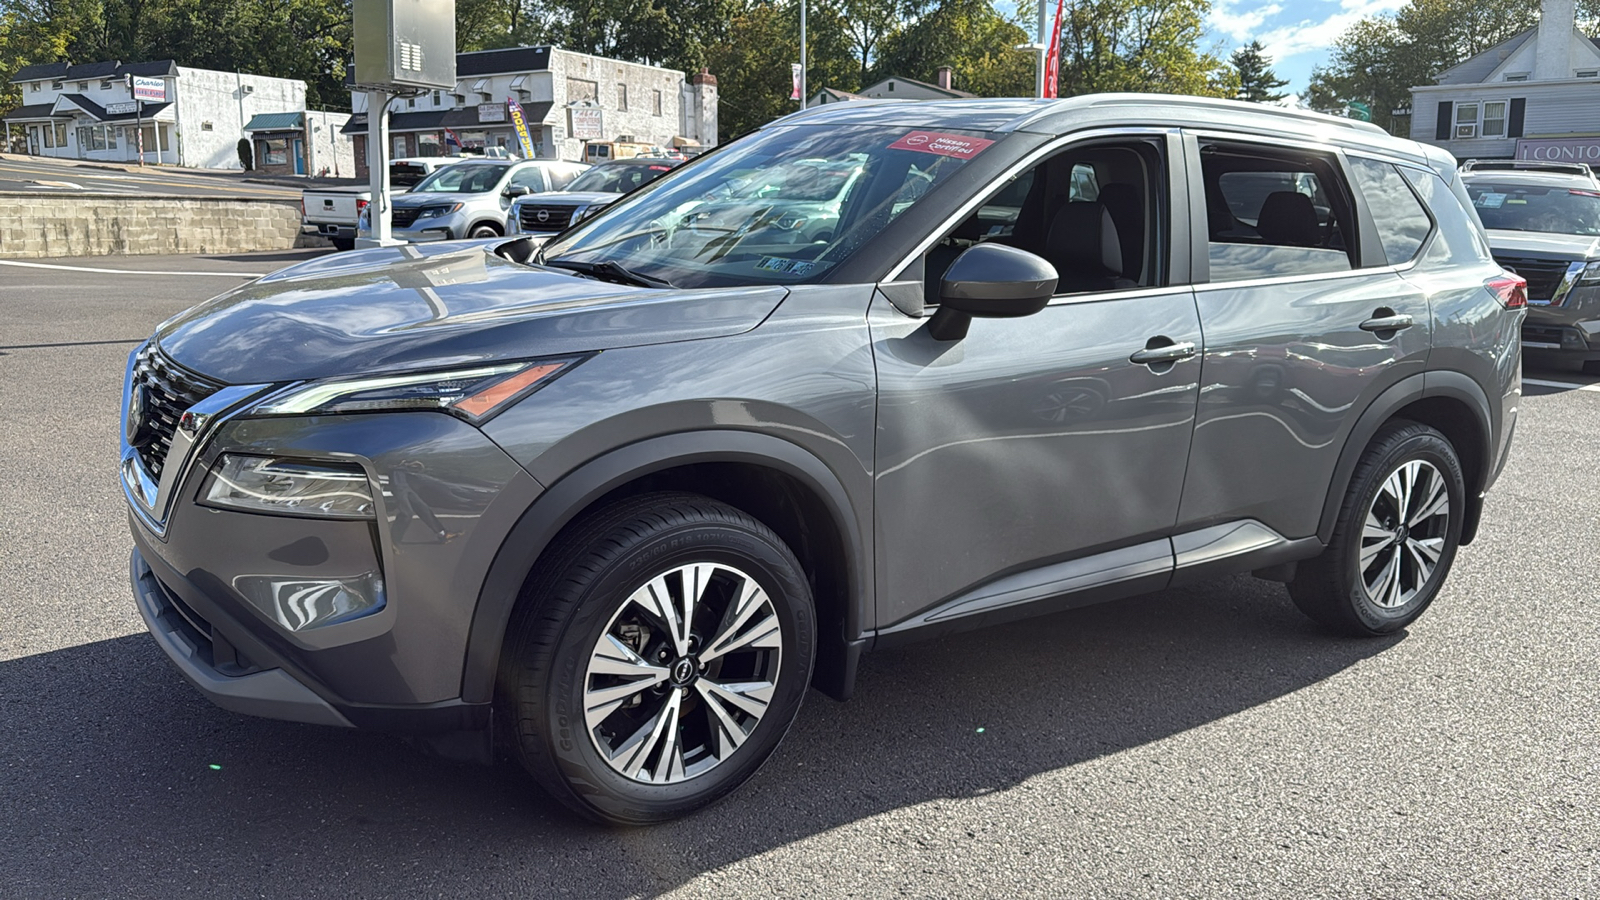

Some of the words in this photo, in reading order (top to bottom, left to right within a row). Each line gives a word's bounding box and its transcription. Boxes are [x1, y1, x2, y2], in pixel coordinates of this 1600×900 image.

[928, 142, 974, 154] Certified
[936, 137, 970, 147] Nissan
[1534, 145, 1600, 160] CONTO
